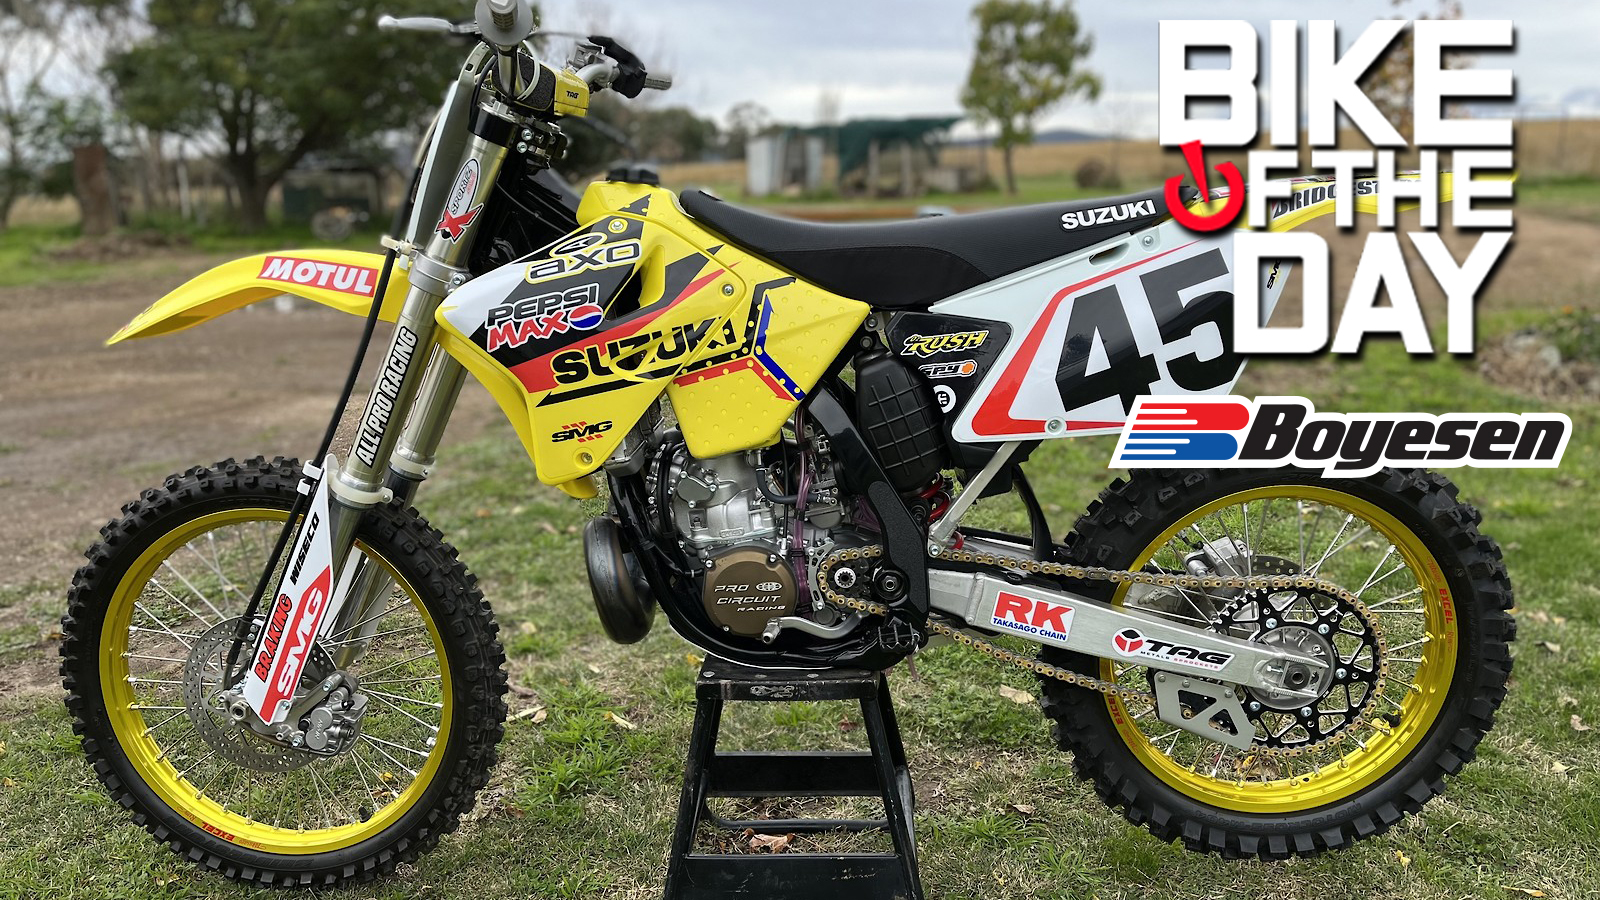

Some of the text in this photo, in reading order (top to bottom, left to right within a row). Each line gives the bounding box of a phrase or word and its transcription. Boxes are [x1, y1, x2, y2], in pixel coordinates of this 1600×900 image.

[1061, 199, 1156, 230] SUZUKI
[262, 258, 373, 294] MOTUL
[488, 284, 599, 327] PEPSI
[488, 311, 568, 351] MAX
[906, 332, 988, 355] RUSH
[1055, 247, 1240, 416] 45
[551, 318, 737, 386] SUZUKI
[355, 326, 418, 468] ALL PRO RACING
[552, 420, 613, 443] SMG
[289, 512, 320, 585] WISECO
[714, 584, 750, 593] PRO
[717, 595, 781, 605] CIRCUIT
[1439, 588, 1454, 624] EXCEL
[992, 617, 1066, 641] TAKASAGO CHAIN
[993, 592, 1072, 634] RK
[254, 593, 293, 683] BRAKING
[277, 587, 323, 697] SMG
[1145, 639, 1230, 665] TAG
[1107, 695, 1124, 725] EXCE
[201, 821, 235, 842] EXCEL
